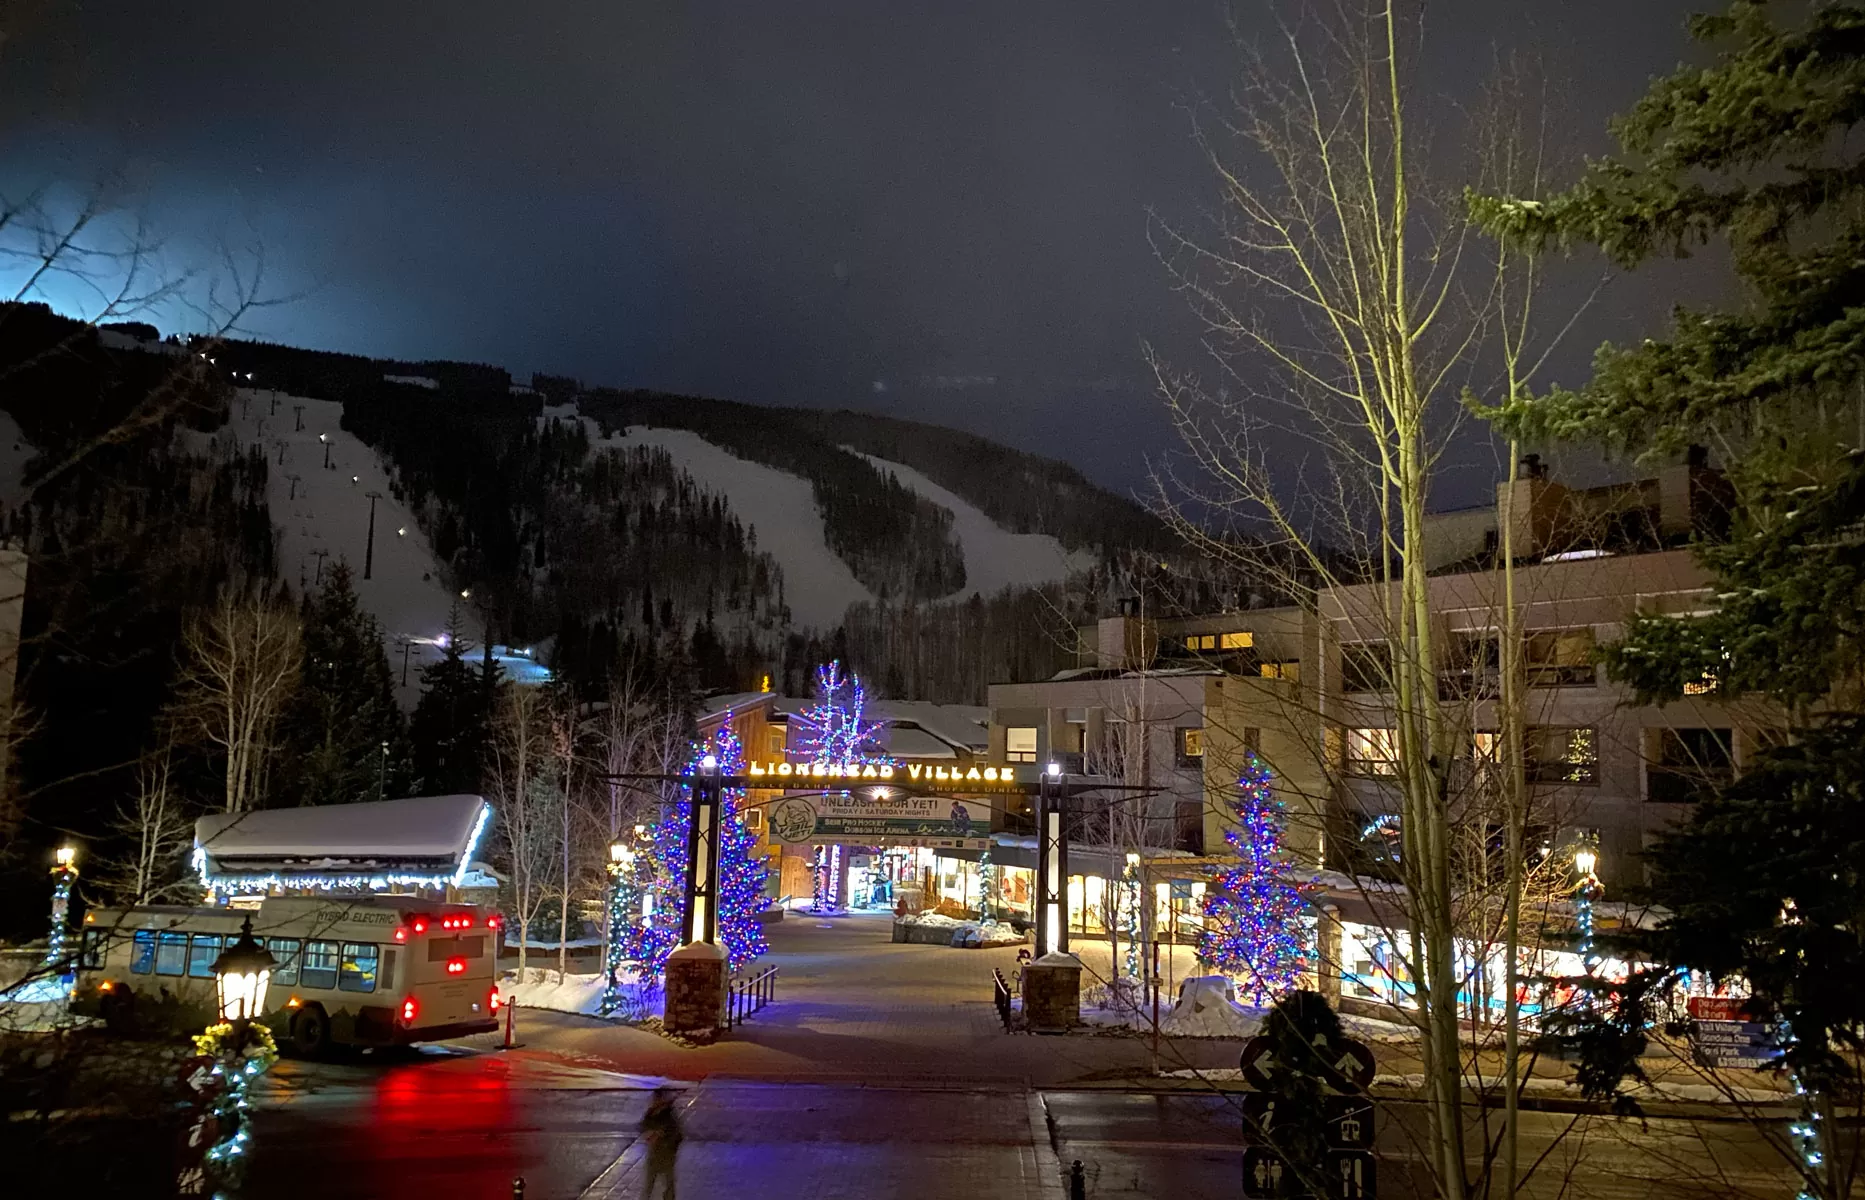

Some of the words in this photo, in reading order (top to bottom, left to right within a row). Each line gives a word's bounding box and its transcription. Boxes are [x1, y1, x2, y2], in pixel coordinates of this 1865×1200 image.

[749, 760, 894, 777] LIONSHEAD
[907, 763, 1014, 781] VILLAGE
[928, 784, 965, 792] SHOPS
[984, 786, 1026, 794] DINING
[820, 797, 875, 808] UNLEASH
[911, 799, 938, 809] YETI
[832, 807, 858, 815] FRIDAY
[865, 808, 903, 816] SATURDAY
[904, 809, 931, 817] NIGHTS
[352, 913, 396, 924] ELECTRIC
[1714, 1023, 1742, 1034] Village
[1720, 1046, 1740, 1056] Park
